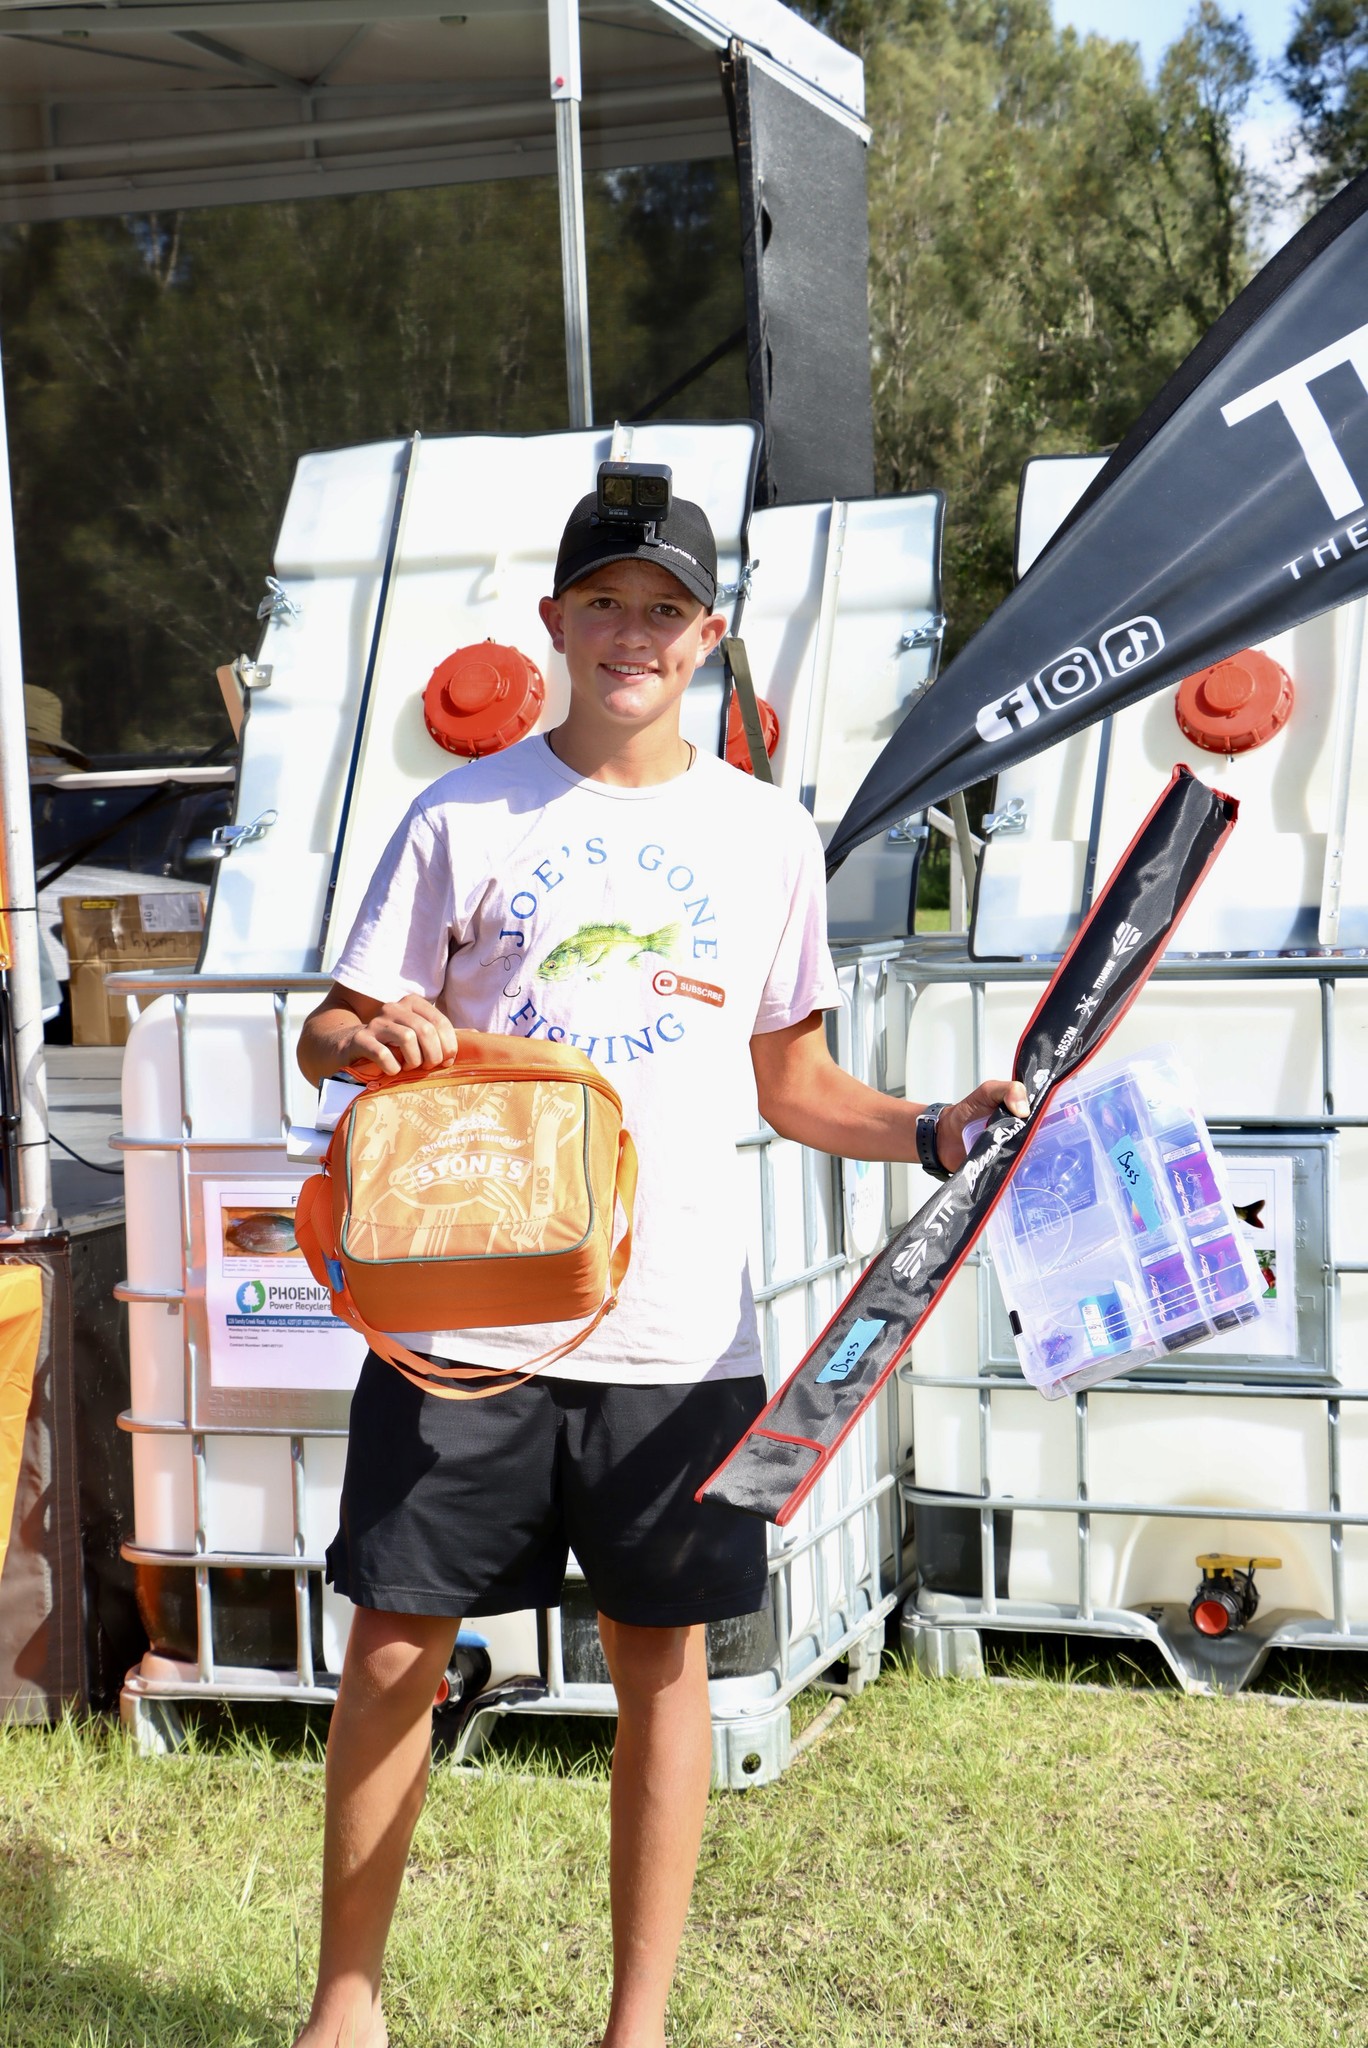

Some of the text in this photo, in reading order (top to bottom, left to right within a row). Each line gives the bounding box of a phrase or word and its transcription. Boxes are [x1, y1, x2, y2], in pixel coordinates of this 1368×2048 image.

[1220, 323, 1368, 521] T
[1282, 518, 1368, 580] THE
[499, 837, 718, 960] JOE'S GONE
[1093, 960, 1116, 990] TITANIUM
[679, 982, 723, 1003] SUBSCRIBE
[508, 999, 685, 1064] FISHING
[1054, 1026, 1078, 1058] S652M
[417, 1155, 524, 1184] STONE'S
[1117, 1150, 1140, 1185] Bass
[269, 1286, 331, 1301] PHOENIX
[269, 1301, 331, 1312] Power Recyclers
[830, 1341, 860, 1374] Bass
